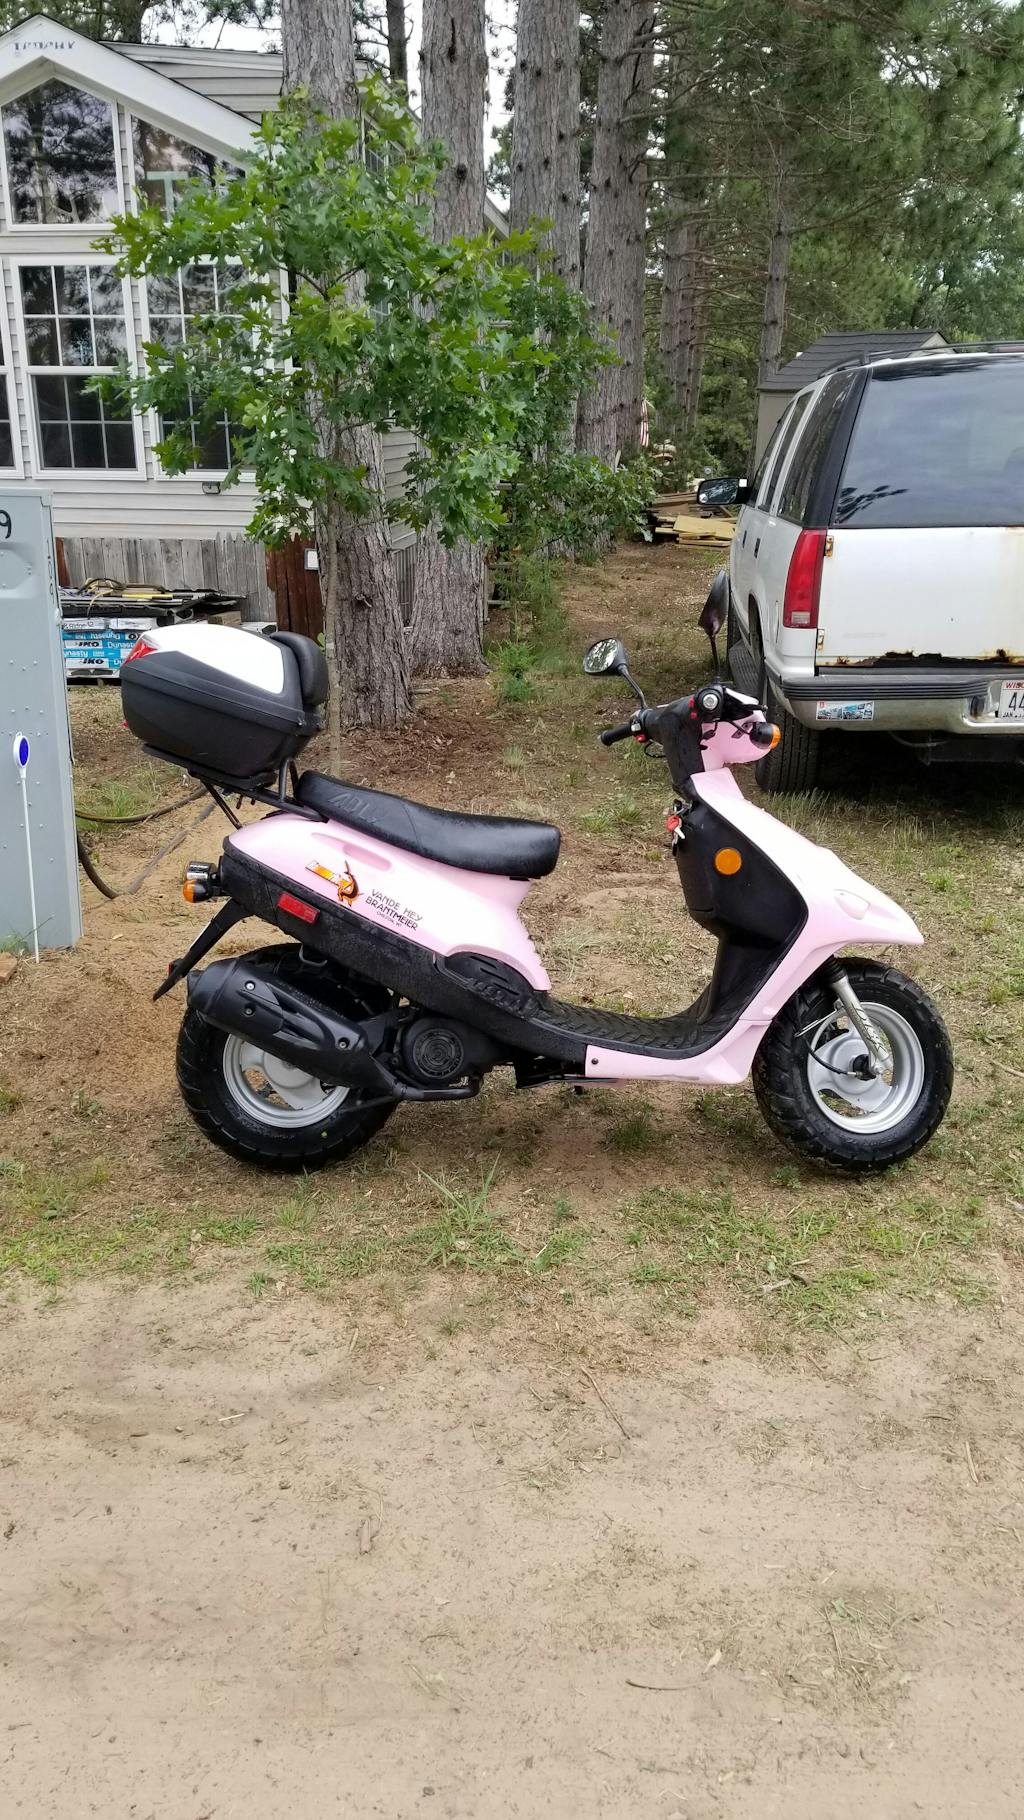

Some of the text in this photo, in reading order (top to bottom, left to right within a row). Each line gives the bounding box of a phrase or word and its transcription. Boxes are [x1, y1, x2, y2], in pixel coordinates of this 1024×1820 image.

[0, 509, 12, 539] 9
[365, 896, 418, 931] BRANTMEIER
[371, 888, 423, 922] VANDE HEY
